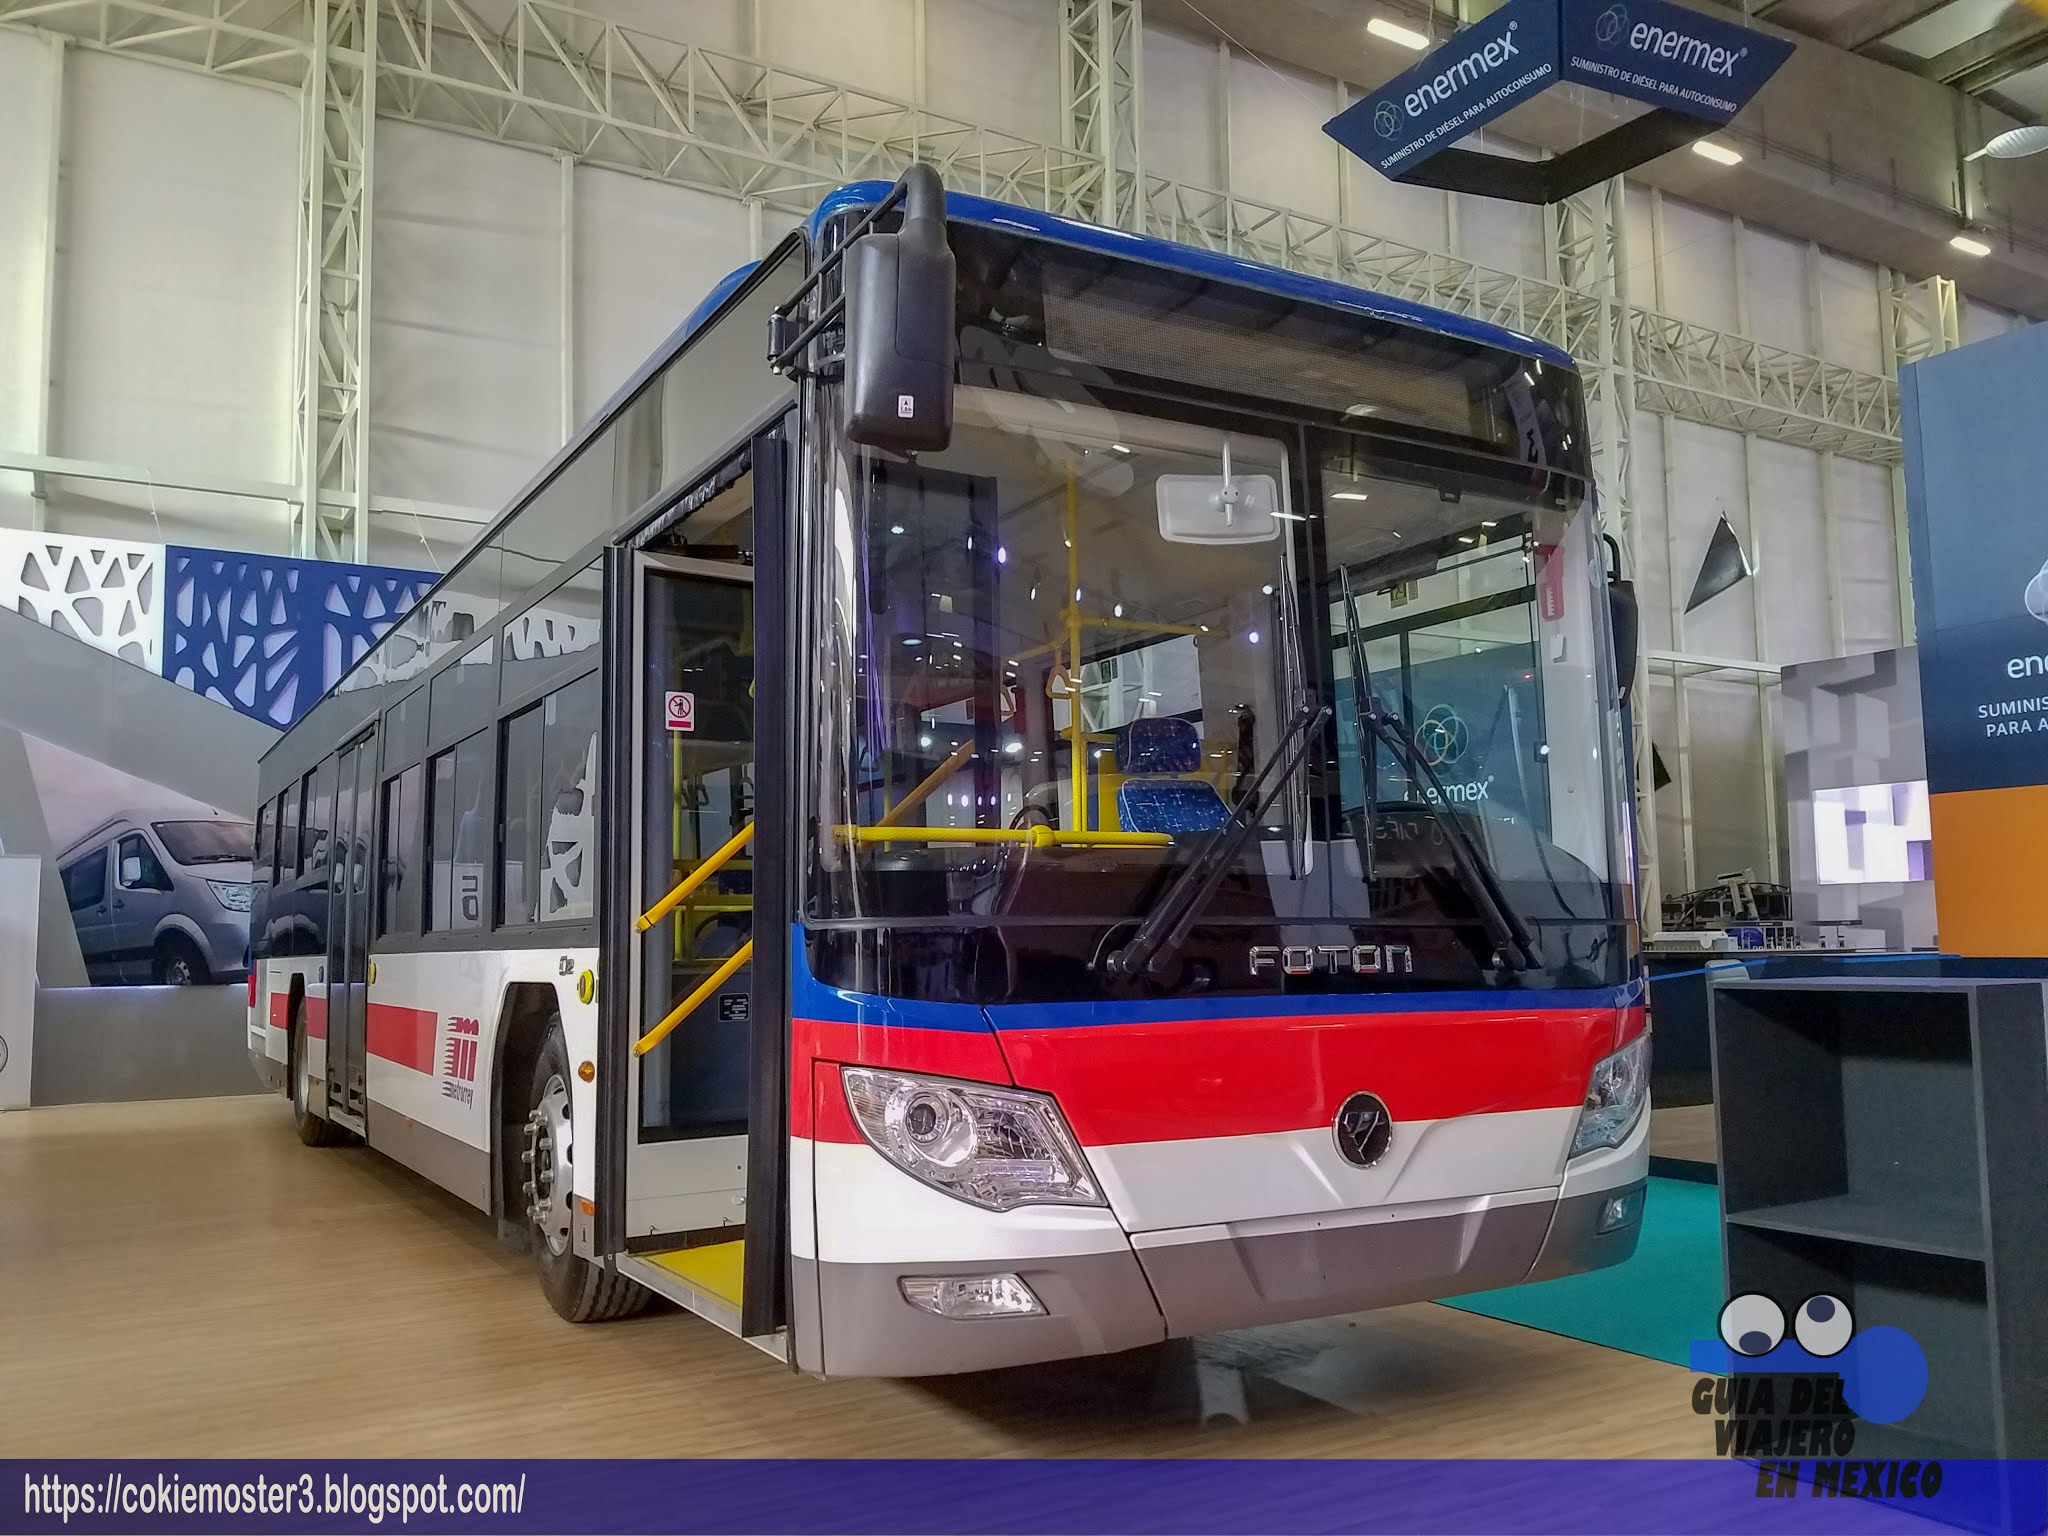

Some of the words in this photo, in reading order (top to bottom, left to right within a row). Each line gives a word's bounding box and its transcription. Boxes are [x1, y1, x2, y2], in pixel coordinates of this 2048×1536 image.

[1570, 56, 1620, 79] SUMINISTRO
[1620, 70, 1631, 83] DE
[1631, 74, 1658, 91] DIÉSEL
[1658, 81, 1680, 97] PARA
[1679, 87, 1738, 113] AUTOCONSUMO
[1380, 138, 1426, 170] SUMINISTRO
[1425, 130, 1438, 144] DE
[1437, 115, 1465, 136] DIÉSEL
[1463, 102, 1487, 120] PARA
[1486, 62, 1553, 108] AUTOCONSUMO
[2007, 654, 2048, 679] en
[1986, 719, 2033, 738] PARA
[1249, 944, 1413, 976] FOTON
